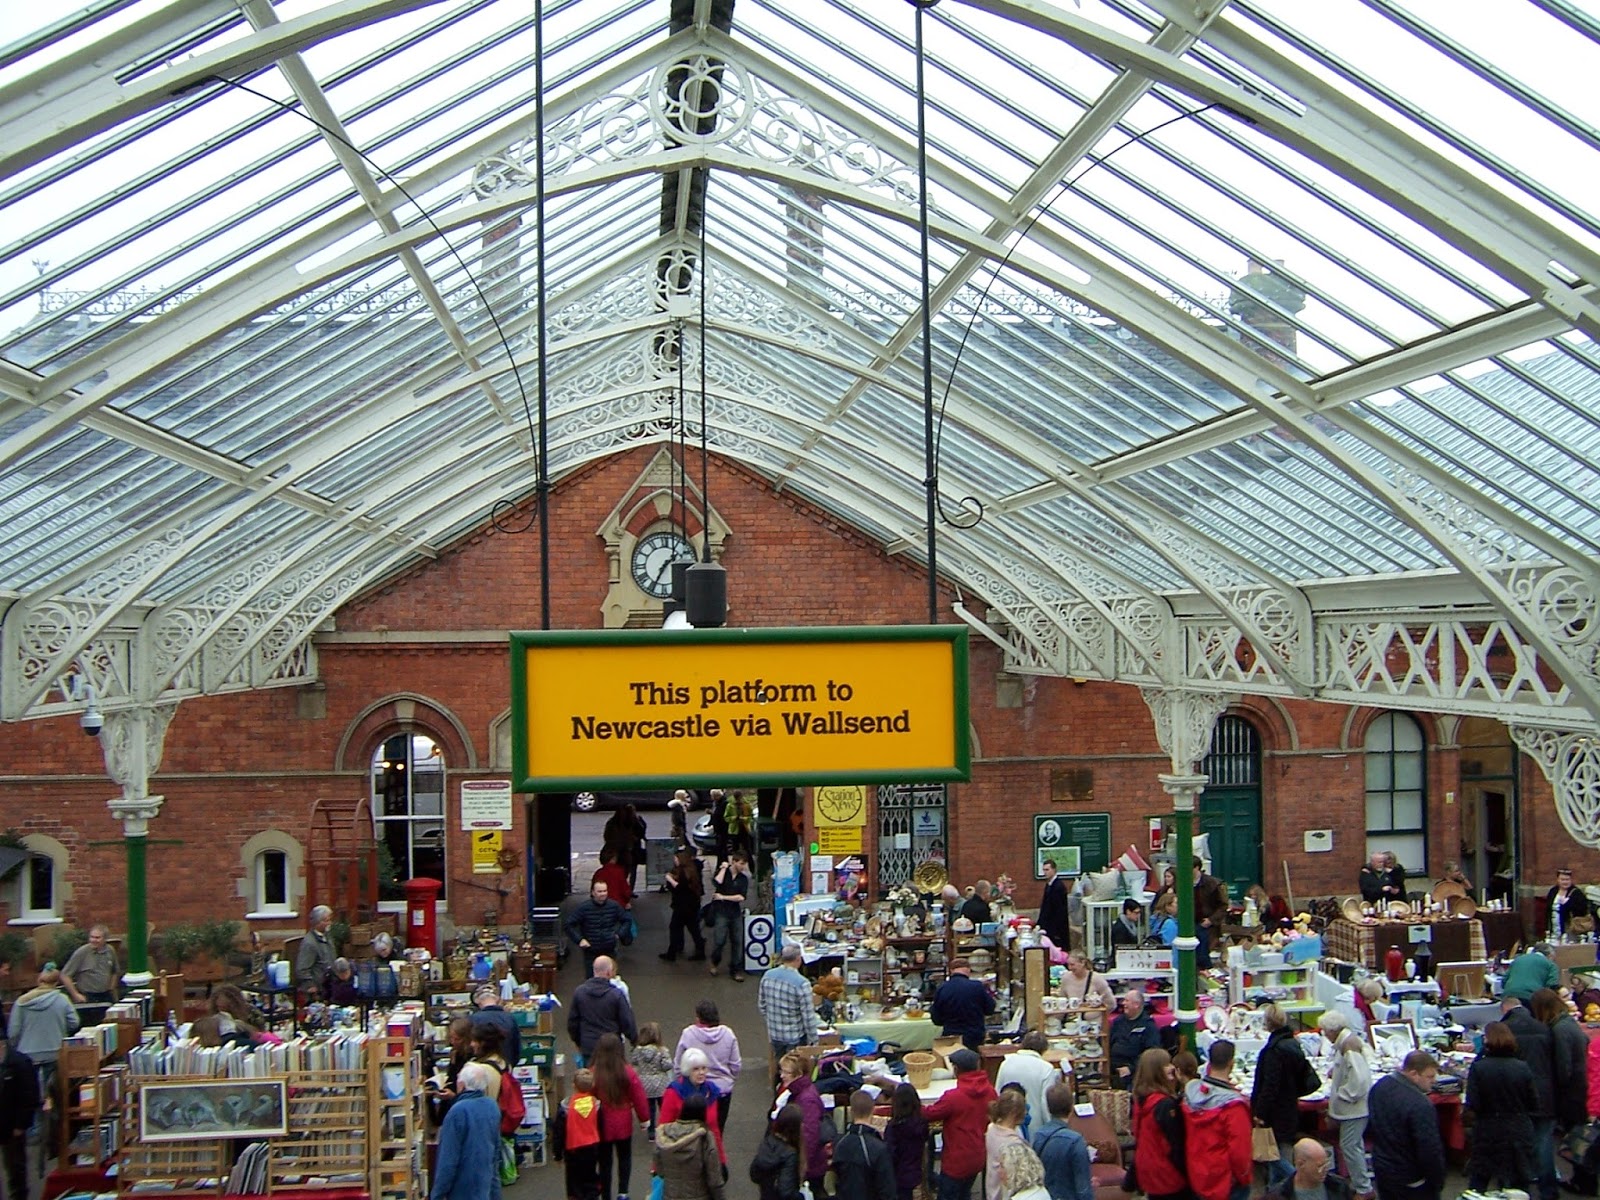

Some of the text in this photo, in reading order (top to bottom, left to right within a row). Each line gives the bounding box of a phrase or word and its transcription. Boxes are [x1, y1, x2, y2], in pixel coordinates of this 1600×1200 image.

[630, 679, 853, 708] This platform to
[571, 710, 910, 739] Newcastle via Wallsend
